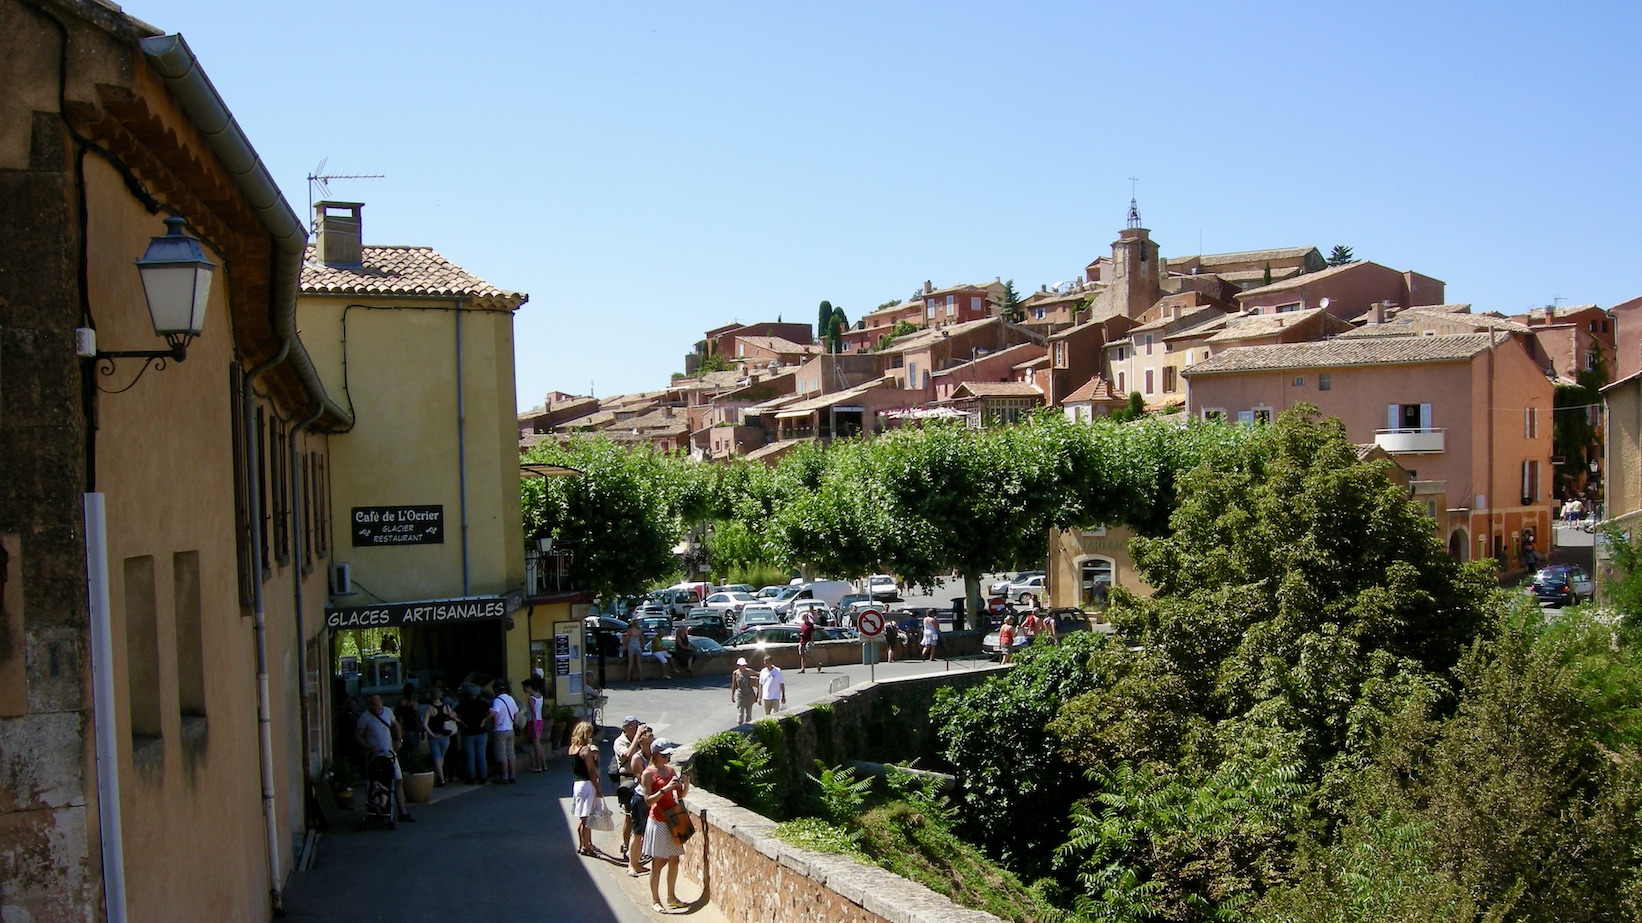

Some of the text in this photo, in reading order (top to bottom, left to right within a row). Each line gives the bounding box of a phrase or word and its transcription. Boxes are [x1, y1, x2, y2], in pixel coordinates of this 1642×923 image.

[355, 509, 439, 523] Café de L'Ocrier
[381, 524, 414, 533] GLACIER
[373, 533, 423, 543] RESTAURANT
[327, 609, 390, 627] GLACES
[402, 602, 504, 623] ARTISANALES
